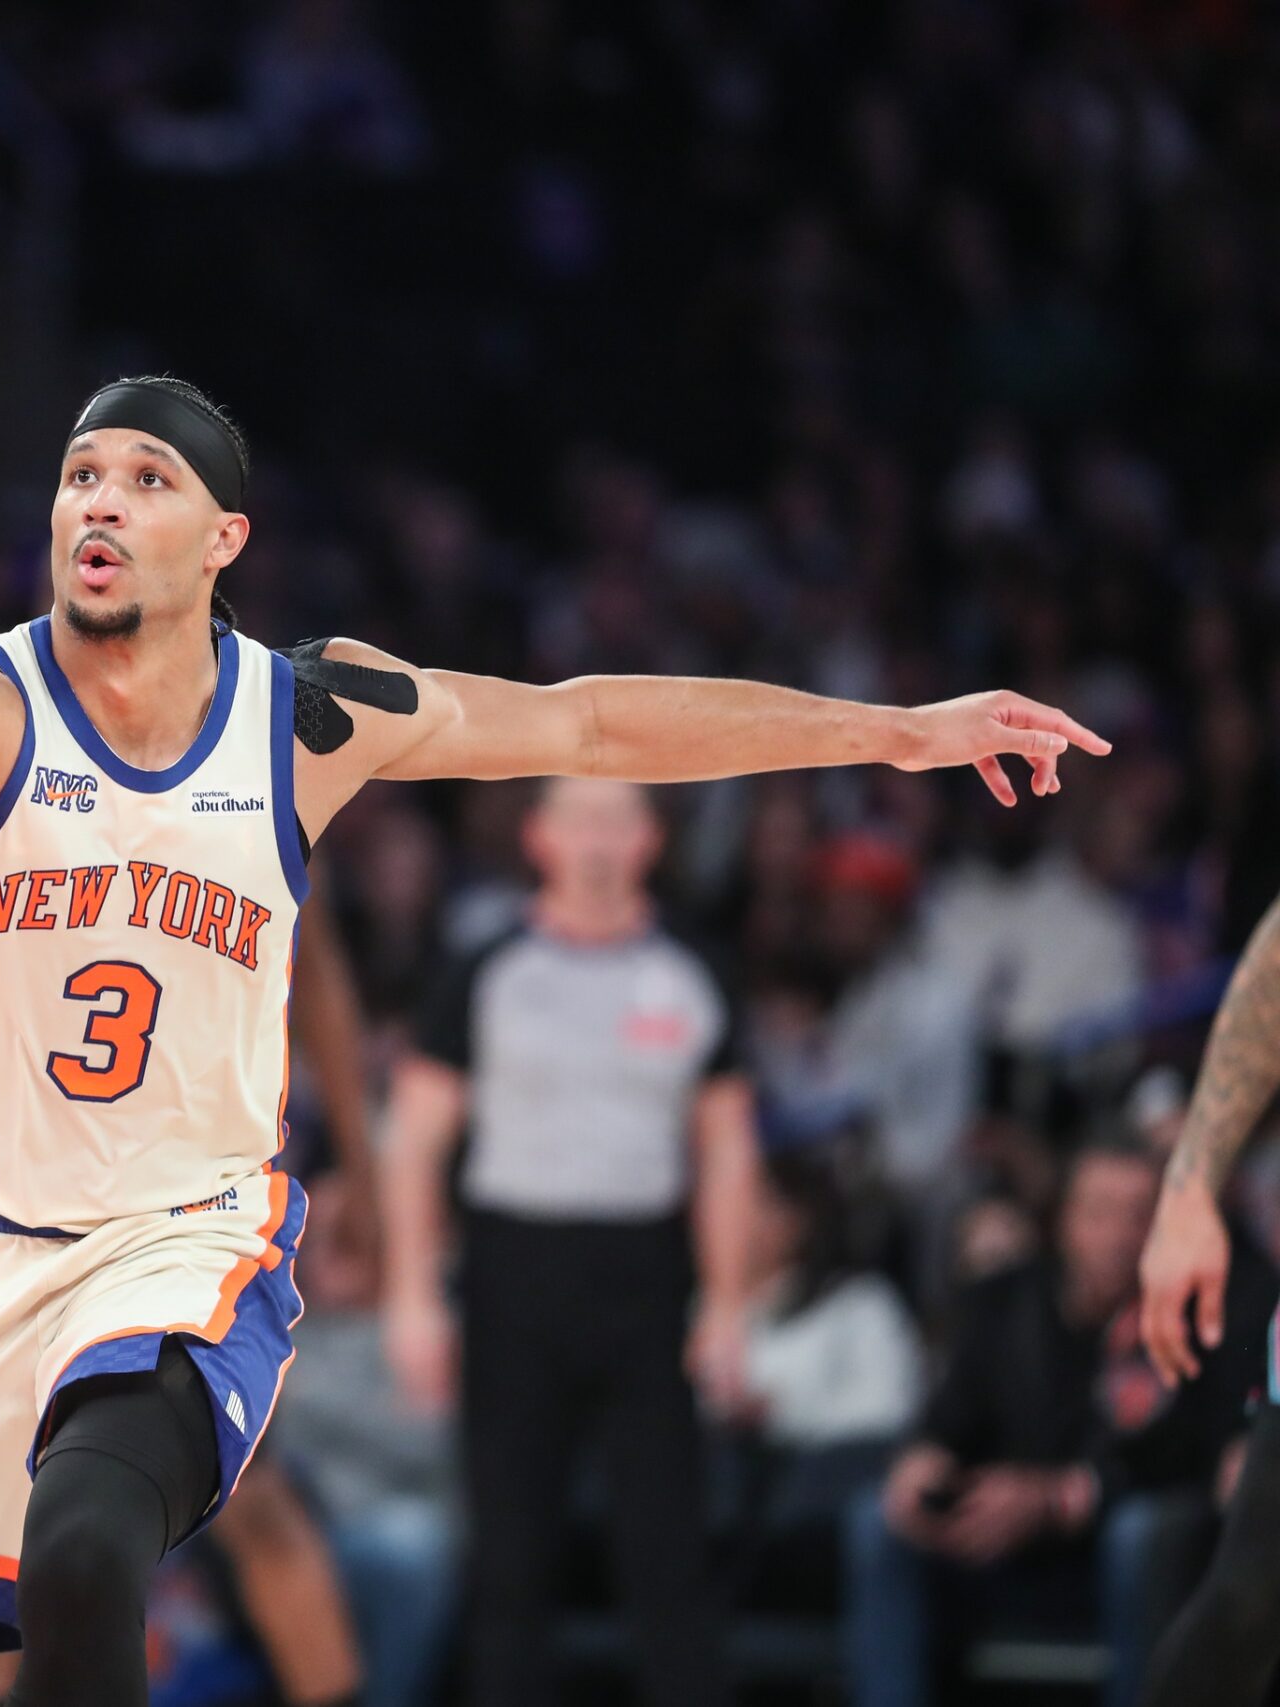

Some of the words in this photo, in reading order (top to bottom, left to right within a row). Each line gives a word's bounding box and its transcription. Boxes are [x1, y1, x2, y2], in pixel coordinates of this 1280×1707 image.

[30, 766, 98, 813] NYC
[192, 790, 230, 798] experience
[192, 799, 219, 812] abu
[127, 861, 272, 971] YORK
[46, 960, 163, 1103] 3
